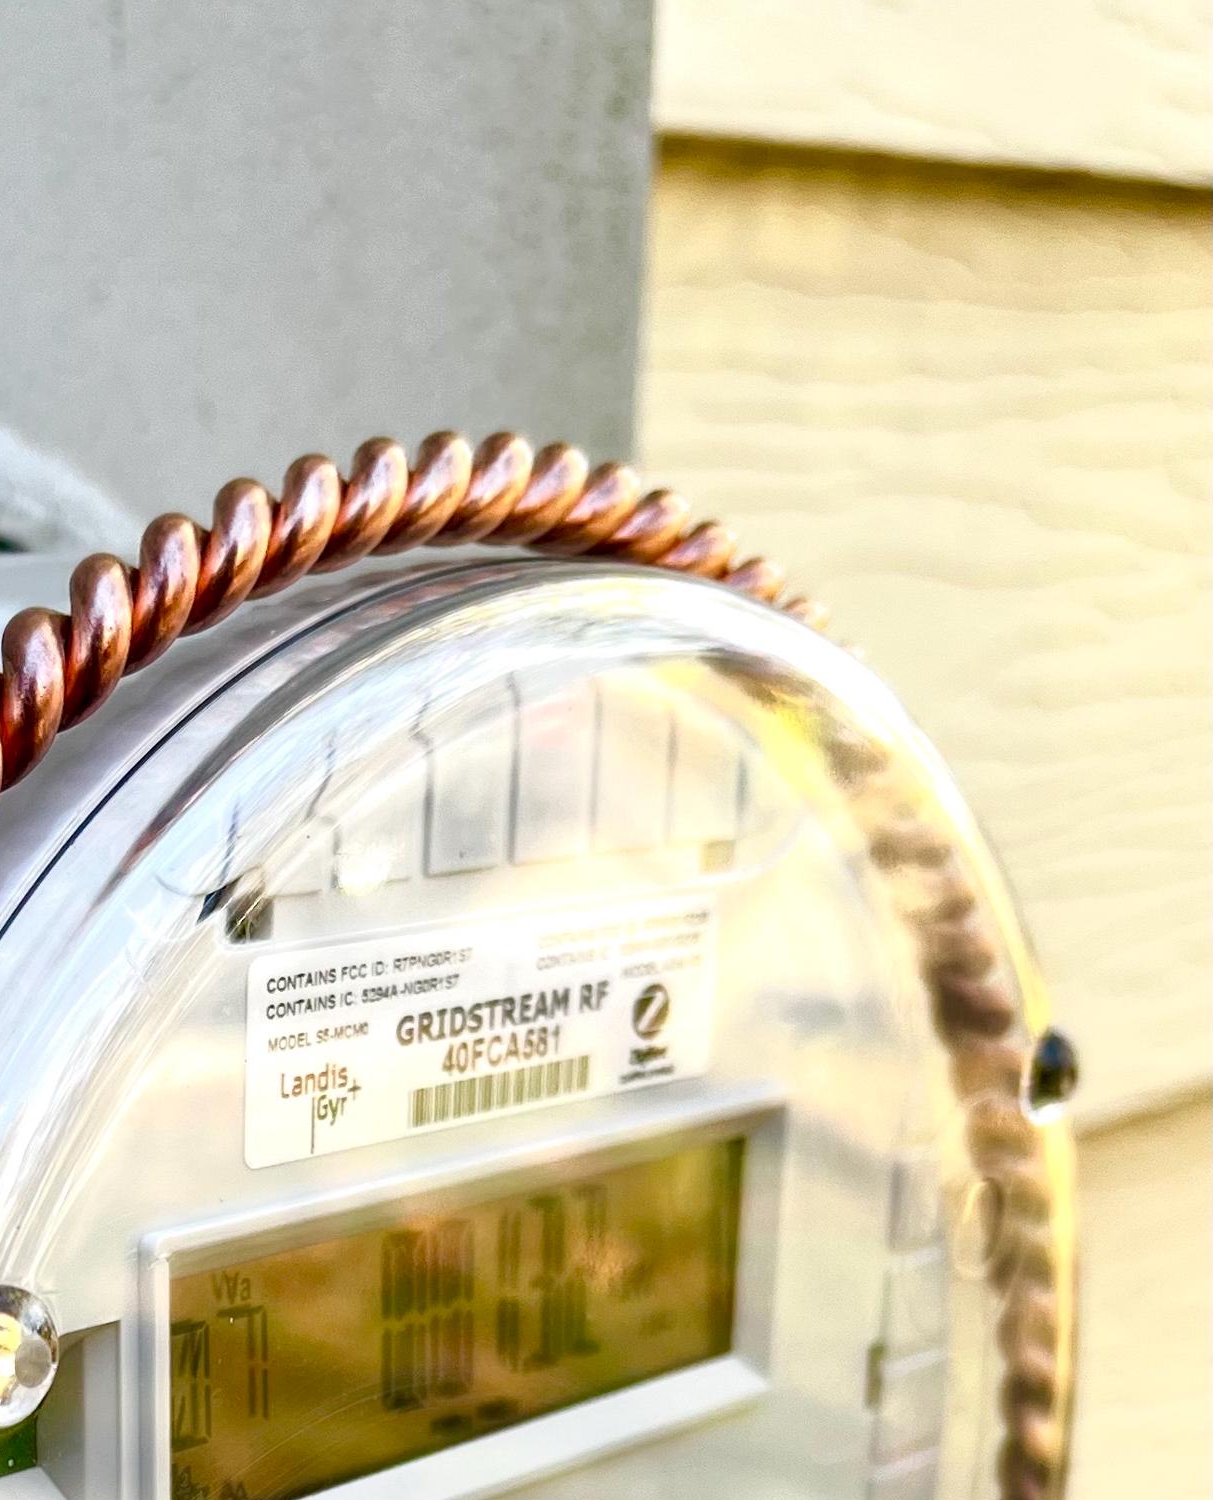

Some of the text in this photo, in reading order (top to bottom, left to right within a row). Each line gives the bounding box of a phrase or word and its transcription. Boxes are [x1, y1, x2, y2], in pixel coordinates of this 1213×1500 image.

[266, 968, 338, 995] CONTAINS
[340, 962, 368, 983] FCC
[370, 960, 390, 978] ID:
[265, 993, 337, 1021] CONTAINS
[339, 991, 358, 1009] IC:
[396, 979, 611, 1047] GRIDSTREAM RF
[267, 1031, 313, 1054] MODEL
[315, 1094, 348, 1127] Gyr
